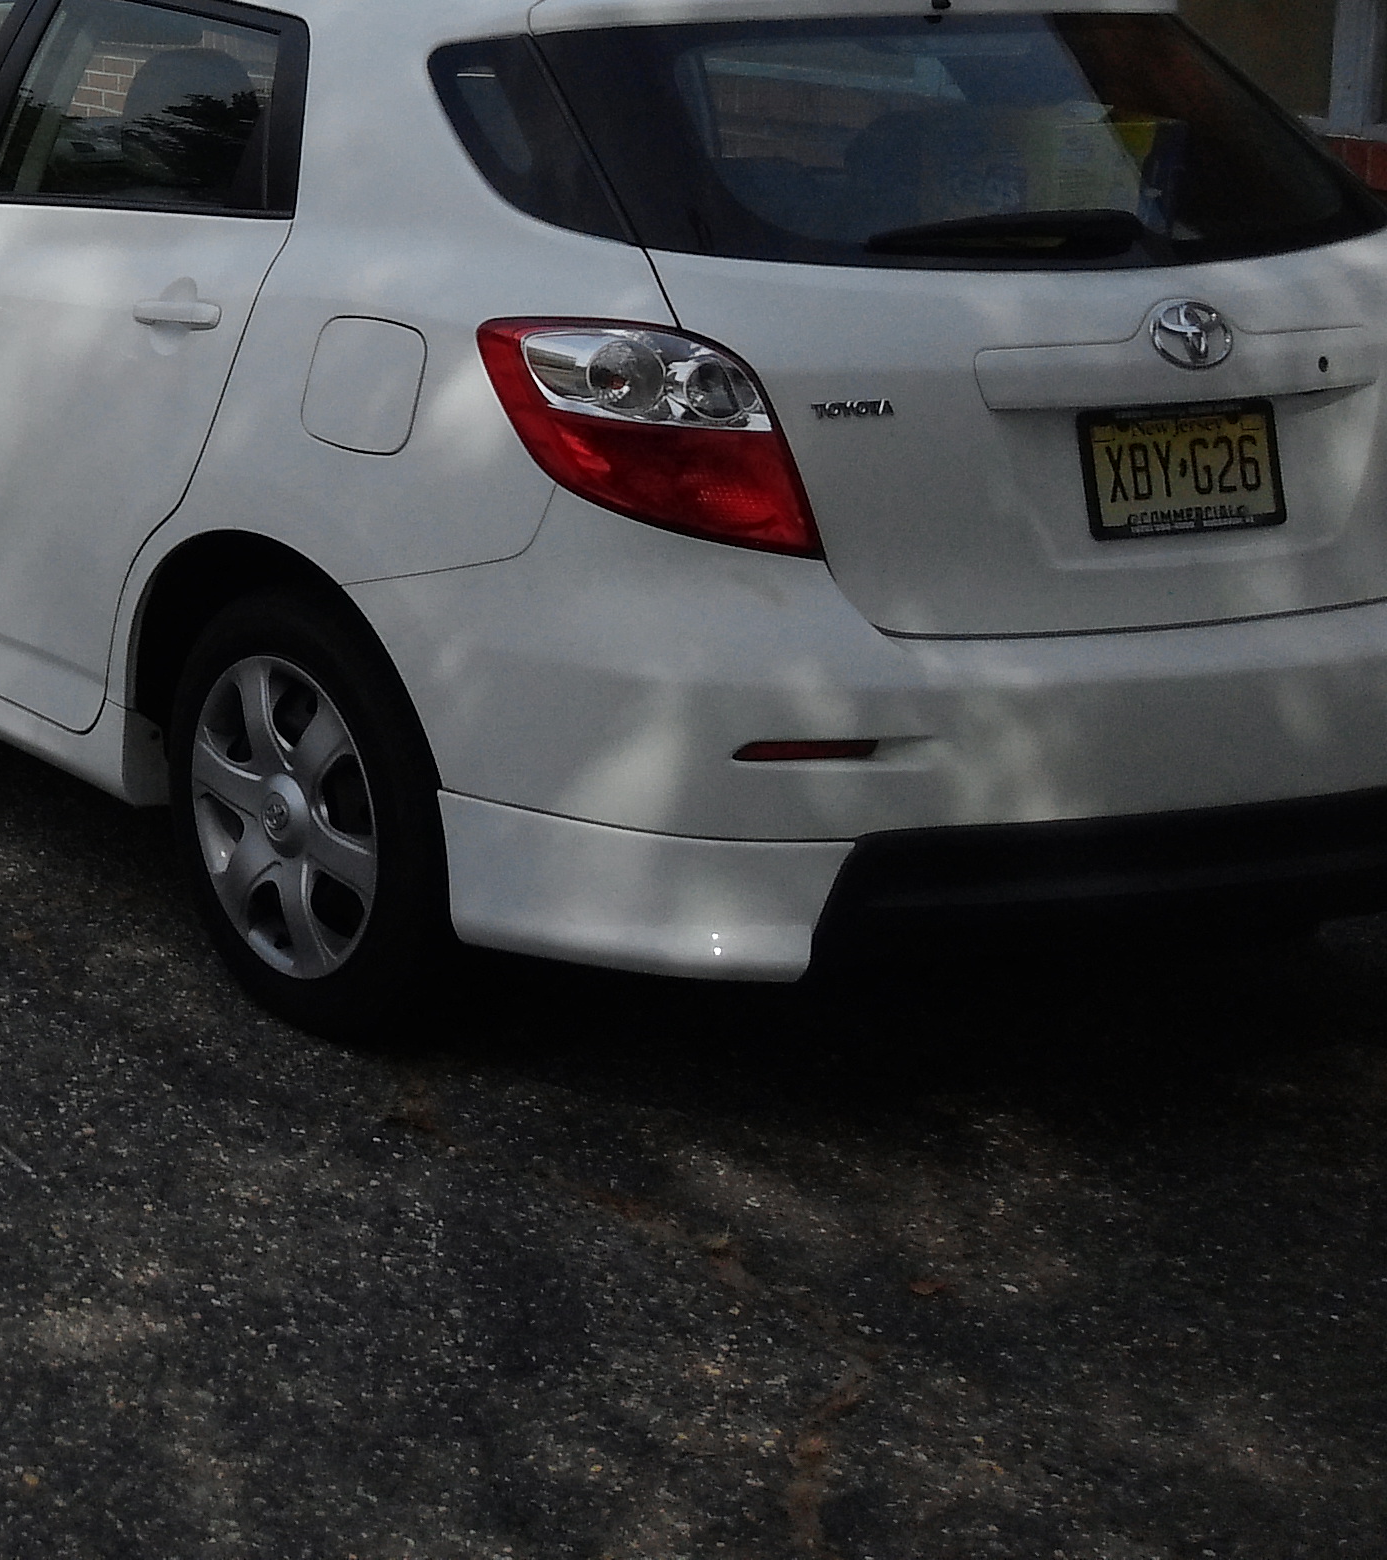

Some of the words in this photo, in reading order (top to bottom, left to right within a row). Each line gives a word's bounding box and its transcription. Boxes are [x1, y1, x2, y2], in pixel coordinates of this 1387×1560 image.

[811, 398, 894, 419] TOYOTA
[1132, 421, 1168, 437] New
[1173, 416, 1221, 437] Jersey
